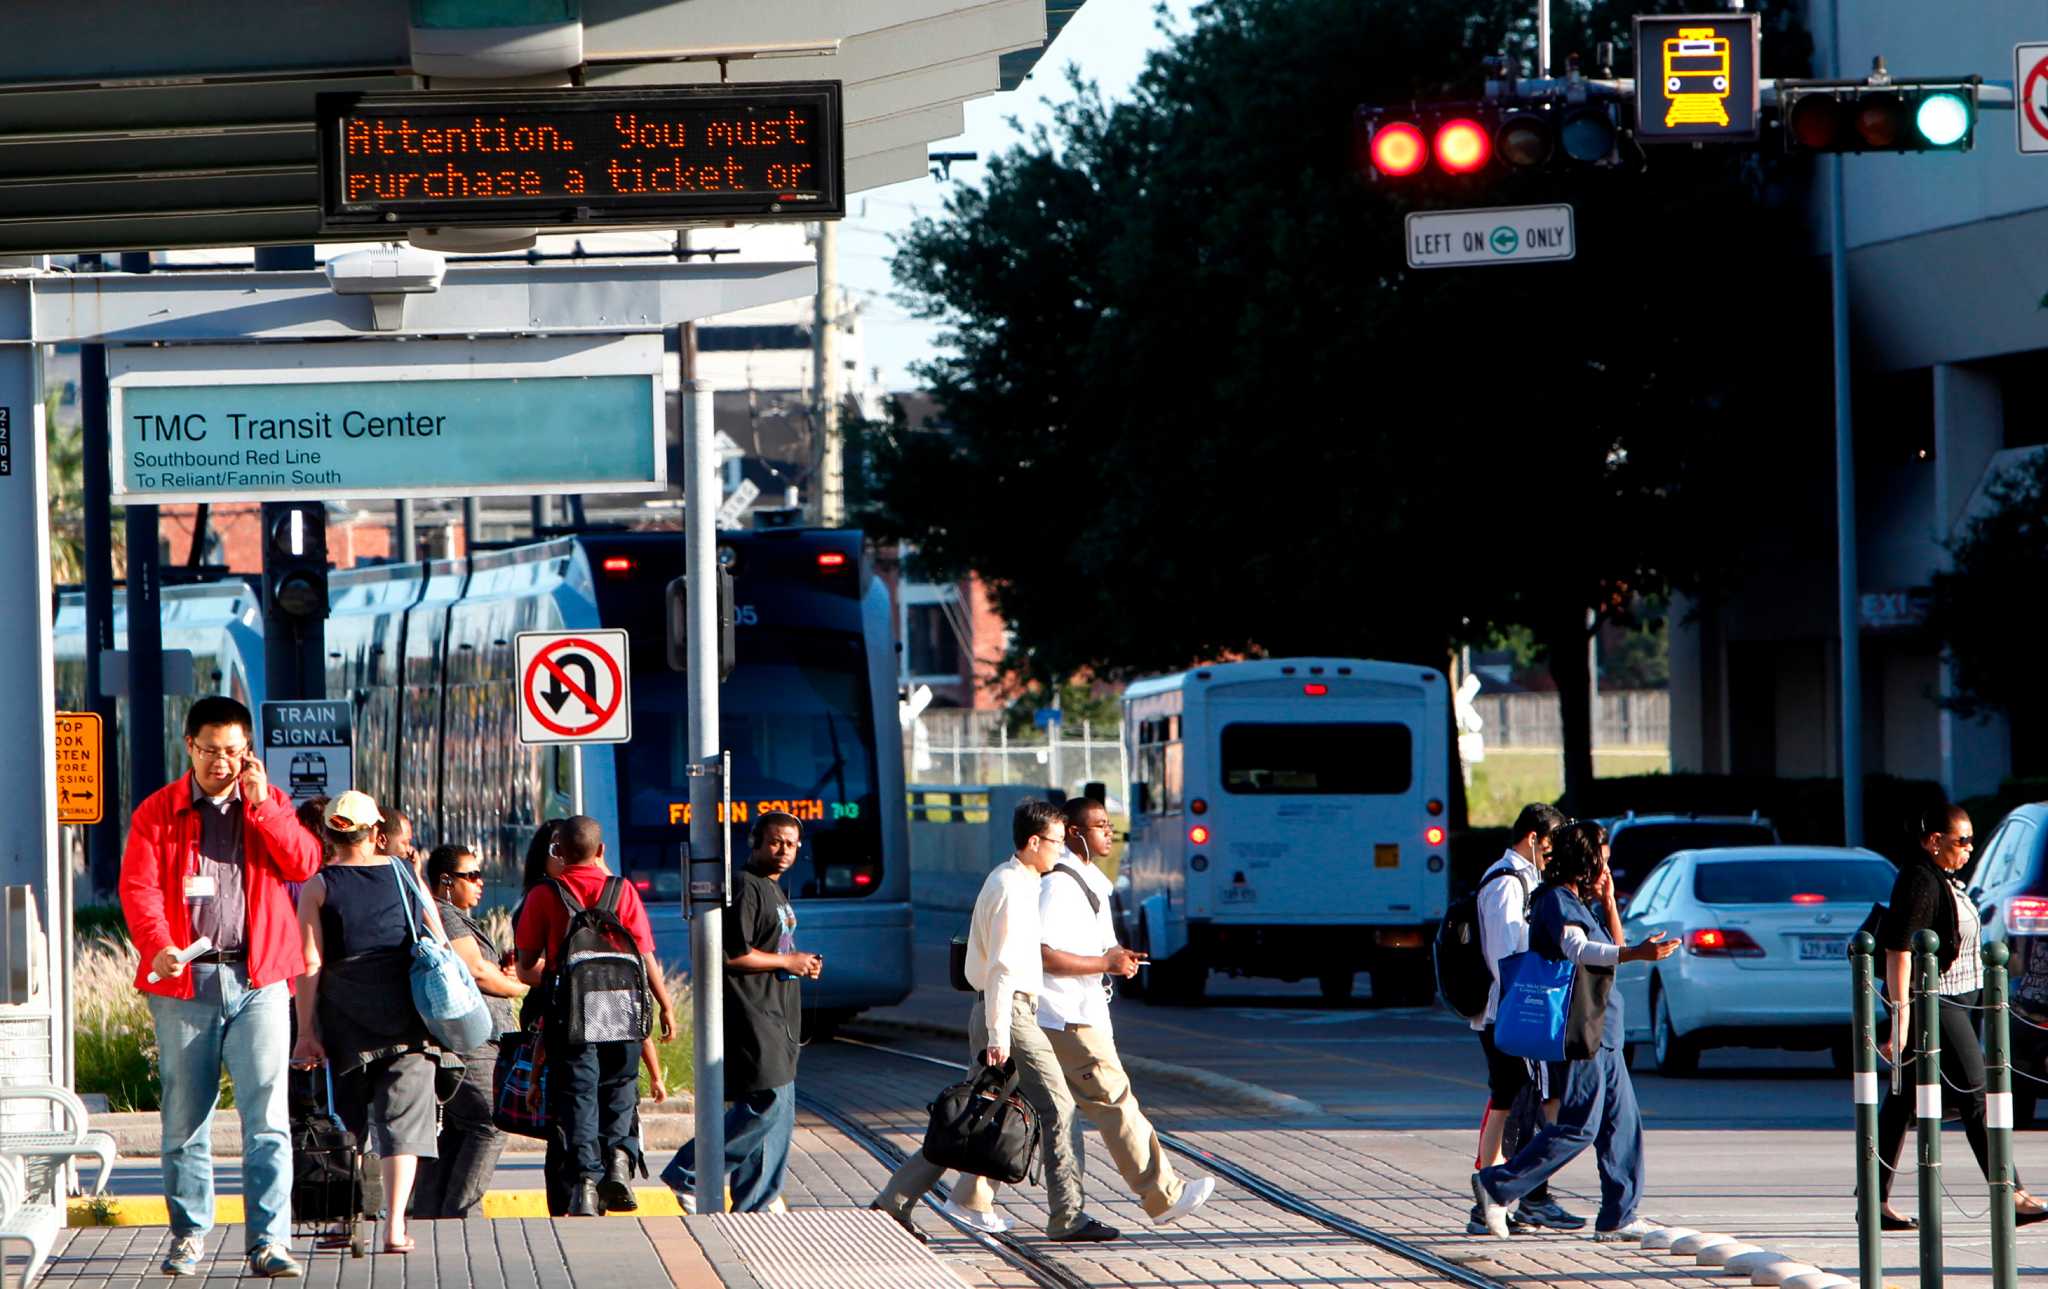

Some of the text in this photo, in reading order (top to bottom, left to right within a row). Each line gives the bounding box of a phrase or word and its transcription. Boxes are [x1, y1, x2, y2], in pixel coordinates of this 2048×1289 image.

[349, 108, 807, 155] Attention. You must
[350, 155, 813, 199] purchase a ticket or
[1415, 226, 1564, 255] LEFT ON ONLY
[133, 410, 446, 441] TMC Transit Center
[133, 449, 321, 468] Southbound Red Line
[135, 470, 342, 488] To Reliant/Fannin South
[276, 706, 336, 722] TRAIN
[56, 721, 83, 733] TOP
[56, 735, 84, 746] OOK
[271, 728, 344, 745] SIGNAL
[56, 749, 90, 761] STEN
[56, 763, 88, 772] FORE
[56, 775, 94, 784] SSING
